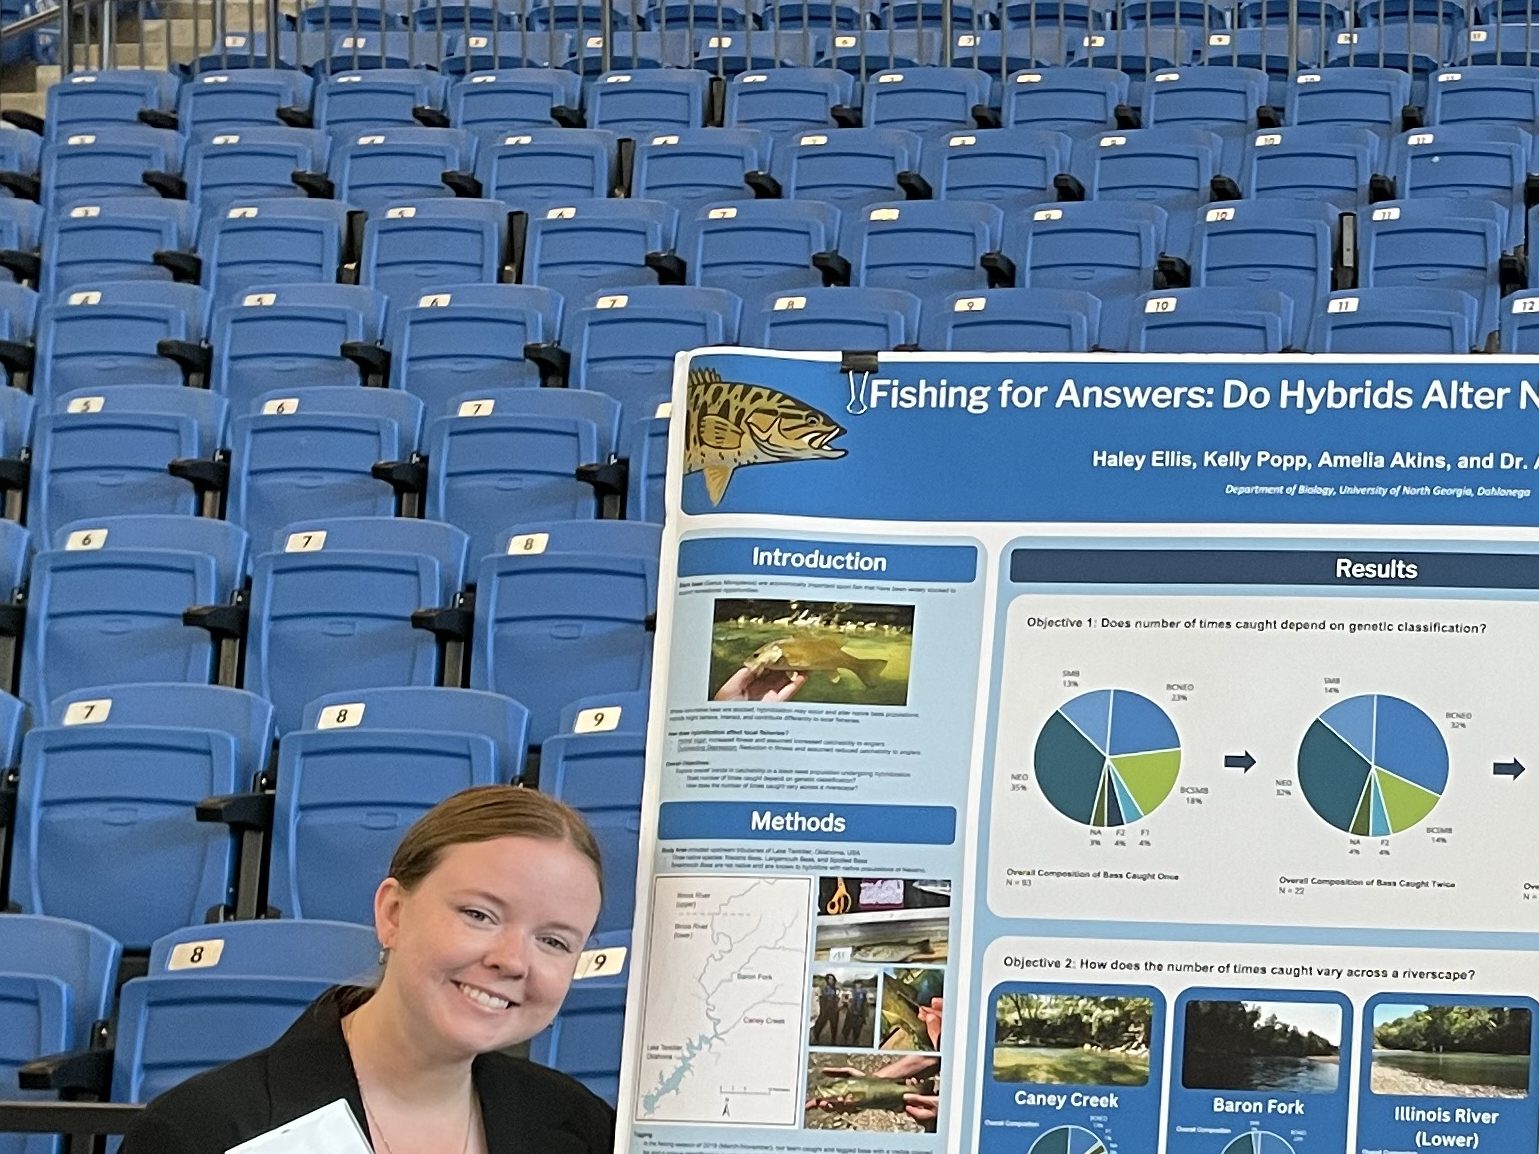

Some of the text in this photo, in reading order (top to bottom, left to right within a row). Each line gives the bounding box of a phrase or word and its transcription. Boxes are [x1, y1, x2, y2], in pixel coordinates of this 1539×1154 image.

[1381, 211, 1392, 219] 11
[608, 299, 617, 309] 7
[967, 301, 974, 311] 9
[1155, 301, 1169, 311] 10
[1338, 301, 1349, 311] 11
[1522, 300, 1535, 311] 12
[870, 379, 990, 414] Fishing
[998, 379, 1048, 409] for
[1056, 380, 1214, 409] Answers:
[1223, 380, 1270, 409] Do
[1280, 379, 1413, 415] Hybrids
[1422, 380, 1510, 410] Alter
[82, 401, 91, 412] 5
[276, 402, 285, 414] 6
[473, 403, 482, 415] 7
[1093, 451, 1146, 471] Haley
[1151, 451, 1197, 470] Ellis,
[1203, 451, 1251, 471] Kelly
[1257, 452, 1312, 471] Popp,
[1318, 451, 1385, 469] Amelia
[1390, 452, 1451, 471] Akins,
[1457, 453, 1494, 470] and
[1500, 453, 1528, 470] Dr.
[1225, 484, 1531, 499] Department of Biology, University of North Georgia, Dahlonega
[81, 534, 92, 546] 6
[302, 535, 313, 548] 7
[523, 538, 533, 551] 8
[753, 547, 887, 572] Introduction
[1336, 558, 1418, 580] Results
[1027, 617, 1083, 630] Objective
[1102, 618, 1131, 629] Does
[1135, 619, 1181, 629] number
[1184, 619, 1197, 629] of
[1200, 619, 1232, 630] times
[1236, 619, 1277, 632] caught
[1281, 620, 1326, 633] depend
[1329, 622, 1345, 631] on
[1349, 621, 1394, 635] genetic
[1397, 621, 1487, 634] classification?
[83, 705, 95, 720] 7
[336, 709, 348, 724] 8
[593, 712, 605, 727] 9
[751, 811, 846, 833] Methods
[1006, 868, 1036, 877] Overall
[1037, 869, 1090, 880] Composition
[1092, 870, 1101, 878] of
[1103, 871, 1123, 879] Bass
[1125, 871, 1156, 882] Caught
[1279, 876, 1456, 889] Overall Composition of Bass Caught Twice
[190, 946, 204, 963] 8
[593, 952, 608, 971] 9
[1004, 957, 1476, 982] Objective 2: How does the number of times caught vary across a riverscape?
[1015, 1091, 1119, 1110] Caney Creek
[1213, 1097, 1305, 1114] Baron Fork
[1394, 1107, 1499, 1125] Illinois River
[1415, 1130, 1480, 1149] (Lower)
